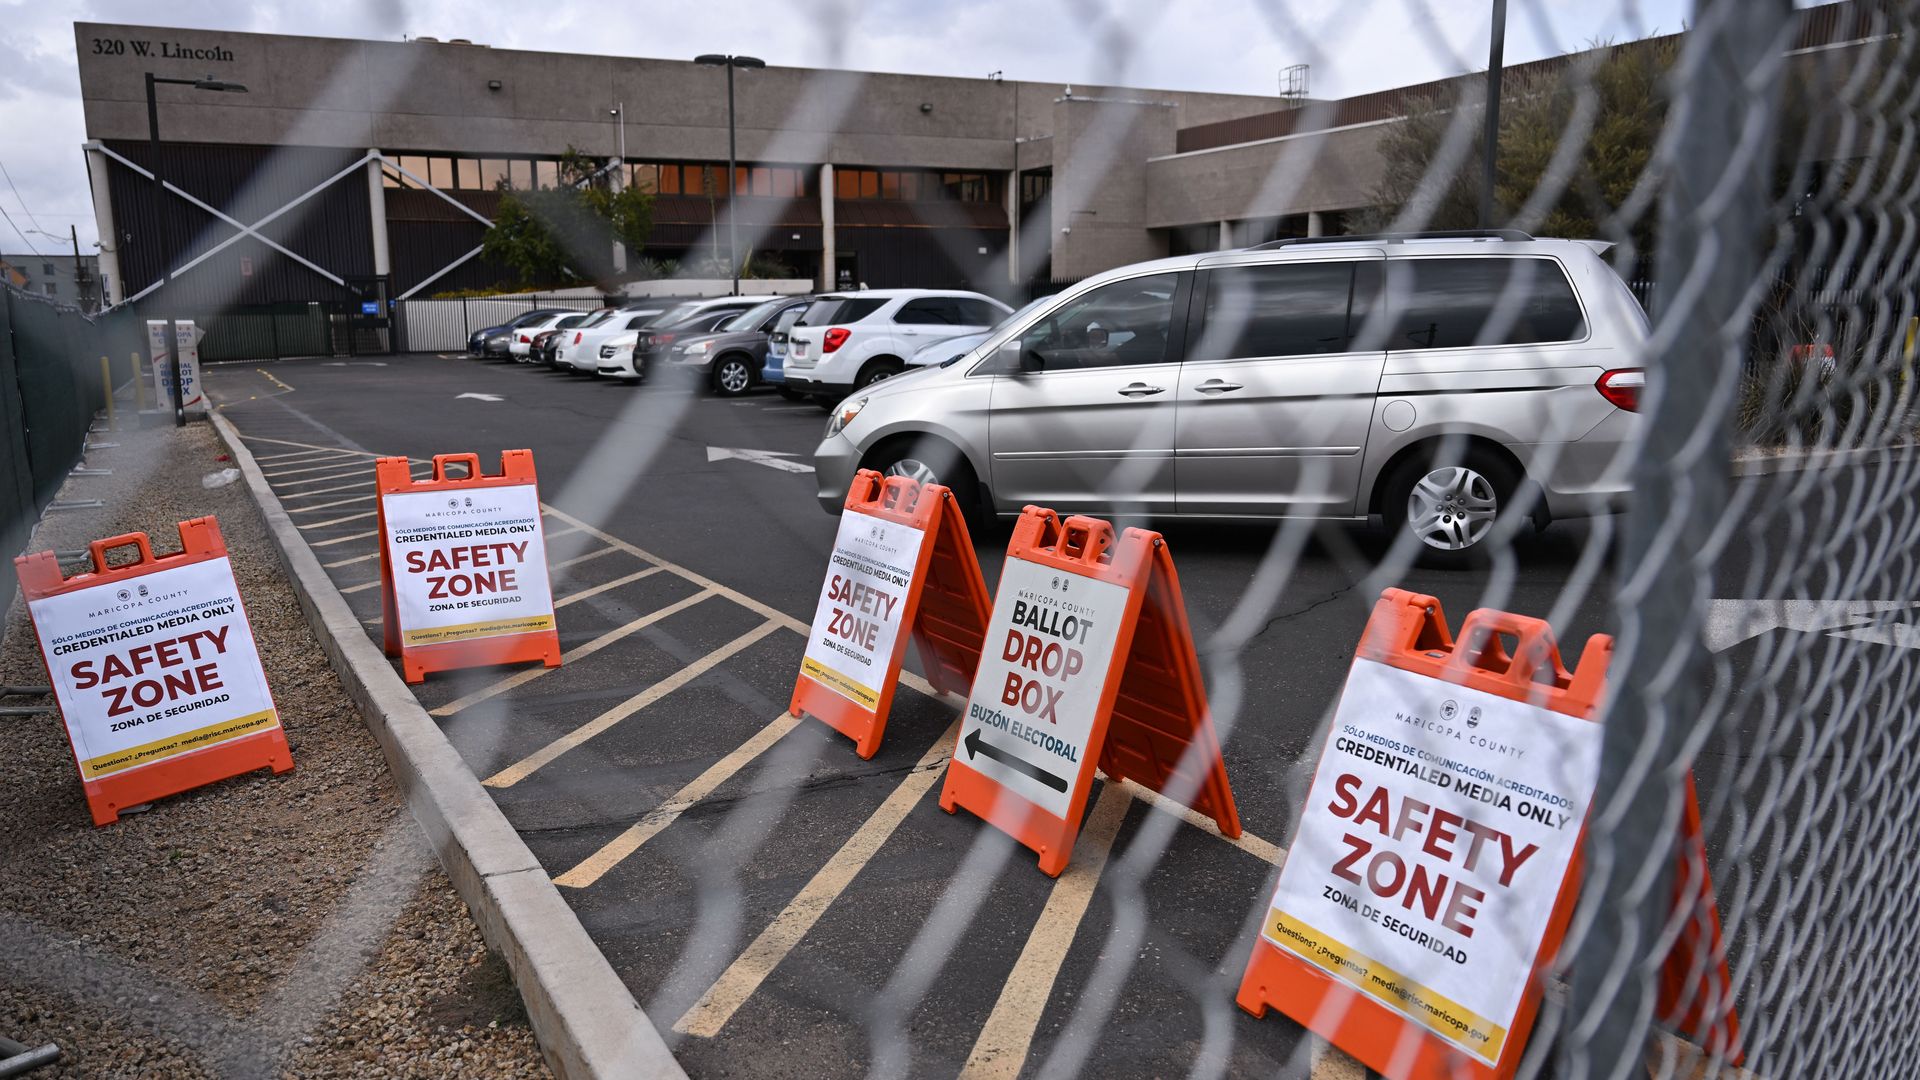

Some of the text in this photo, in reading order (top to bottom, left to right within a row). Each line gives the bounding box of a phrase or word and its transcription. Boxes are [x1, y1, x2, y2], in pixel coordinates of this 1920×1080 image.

[92, 39, 234, 61] 320 W. Lincoln
[167, 387, 191, 396] BX
[395, 524, 536, 544] CREDENTIALED MEDIA ONLY
[425, 510, 467, 518] MARICOPA
[446, 521, 493, 530] COMUNICACIÓN
[494, 518, 535, 526] ACREDITADOS
[406, 540, 529, 573] SAFETY
[833, 554, 909, 588] CREDENTIALED MEDIA ONLY
[88, 589, 189, 619] MARICOPA COUNTY
[426, 569, 518, 599] ZONE
[429, 603, 455, 612] ZONA
[471, 595, 522, 608] SEGURIDAD
[827, 574, 898, 622] SAFETY
[1018, 590, 1096, 617] MARICOPA COUNTY
[51, 596, 233, 646] SÓLO MEDIOS DE COMUNICACIÓN ACREDITADOS
[53, 603, 236, 656] CREDENTIALED MEDIA ONLY
[827, 607, 880, 652] ZONE
[1011, 600, 1094, 645] BALLOT
[70, 625, 230, 690] SAFETY
[822, 637, 872, 667] ZONA DE SEGURIDAD
[1002, 628, 1084, 682] DROP
[102, 662, 224, 718] ZONE
[110, 693, 230, 732] ZONA DE SEGURIDAD
[1001, 671, 1064, 725] BOX
[92, 716, 268, 771] Questions? ¿Preguntas? media@risc.maricopa.gov
[970, 703, 1077, 764] BUZÓN ELECTORAL
[1395, 712, 1526, 760] MARICOPA COUNTY
[1335, 737, 1571, 831] CREDENTIALED MEDIA ONLY
[1343, 724, 1575, 811] SÓLO MEDIOS DE COMUNICACIÓN ACREDITADOS
[1327, 773, 1540, 888] SAFETY
[1331, 833, 1486, 938] ZONE
[1322, 885, 1467, 965] ZONA DE SEGURIDAD
[1276, 922, 1490, 1043] Questions? ¿Preguntas? media@risc.maricopa.gov
